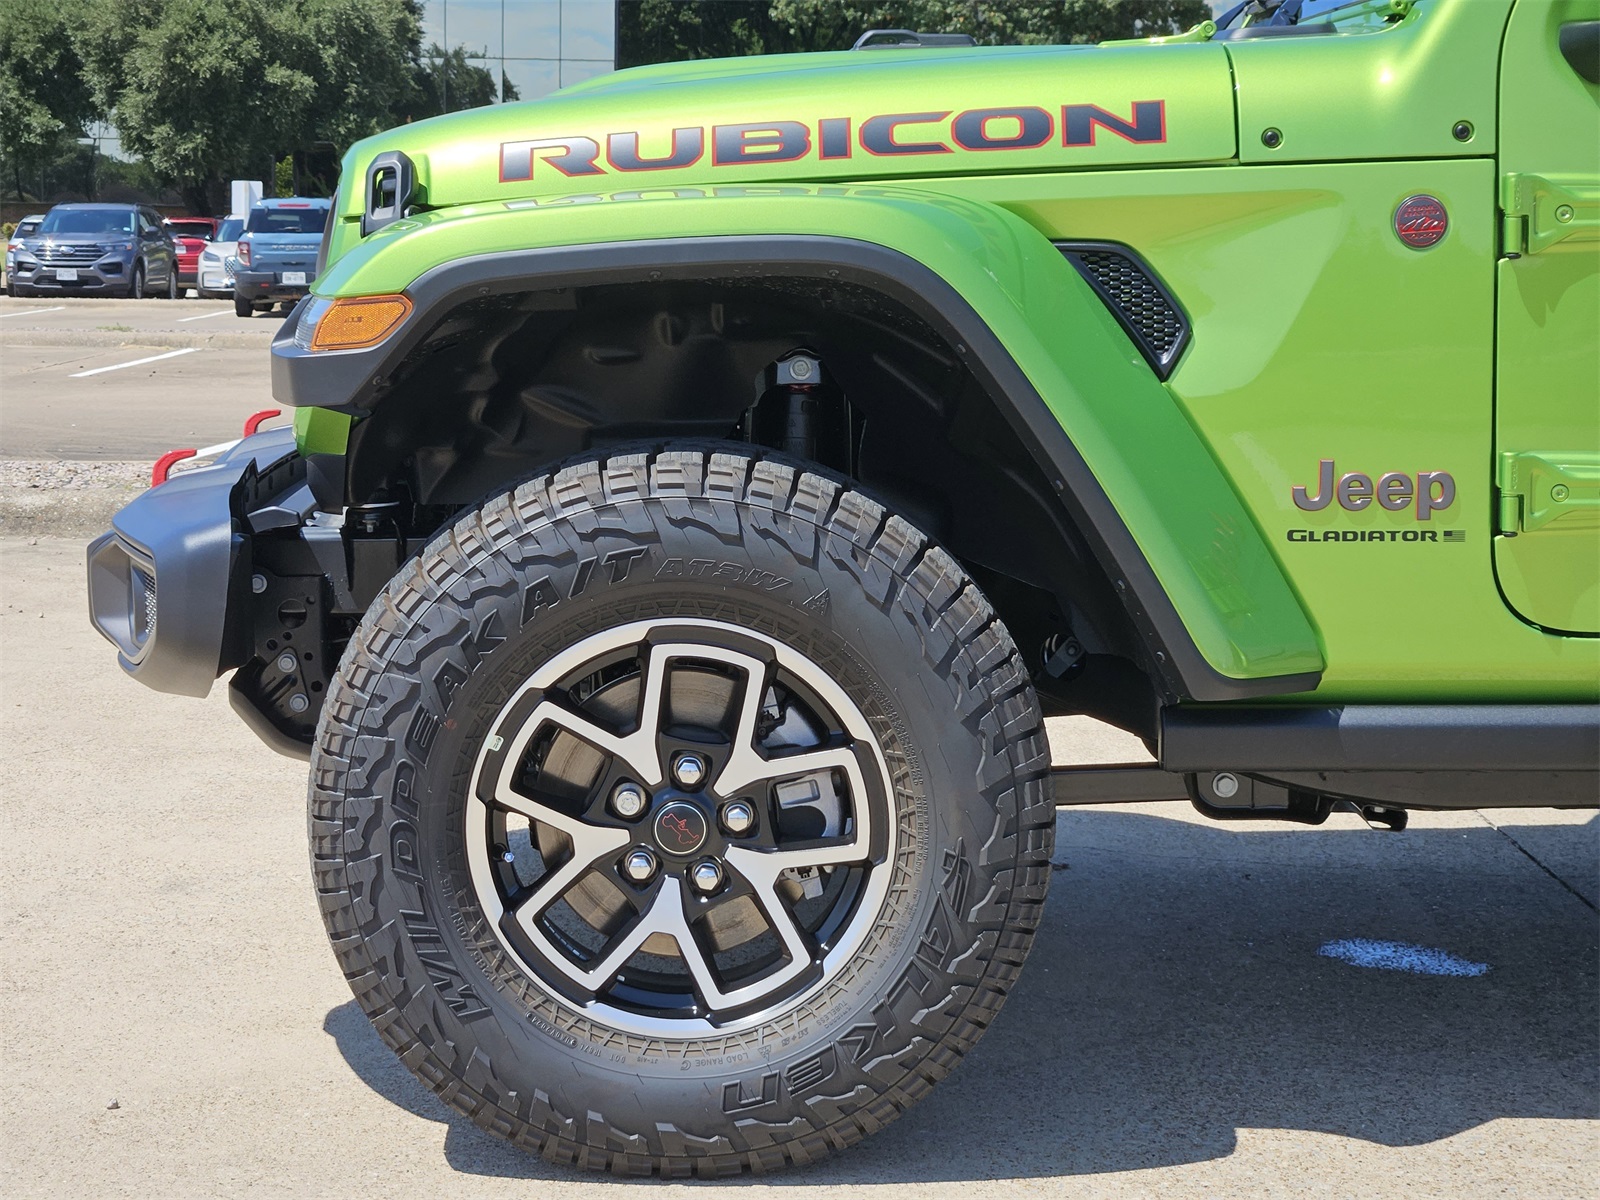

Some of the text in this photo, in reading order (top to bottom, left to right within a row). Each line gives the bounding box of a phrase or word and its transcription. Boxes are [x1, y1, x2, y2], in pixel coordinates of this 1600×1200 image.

[499, 99, 1166, 183] RUBICON
[1291, 458, 1456, 521] Jeep
[1287, 529, 1438, 542] GLADIATOR
[388, 607, 507, 1025] WILDPEAK
[815, 998, 848, 1027] TUBELESS
[694, 1056, 723, 1067] RANGE
[725, 1051, 749, 1063] LOAD
